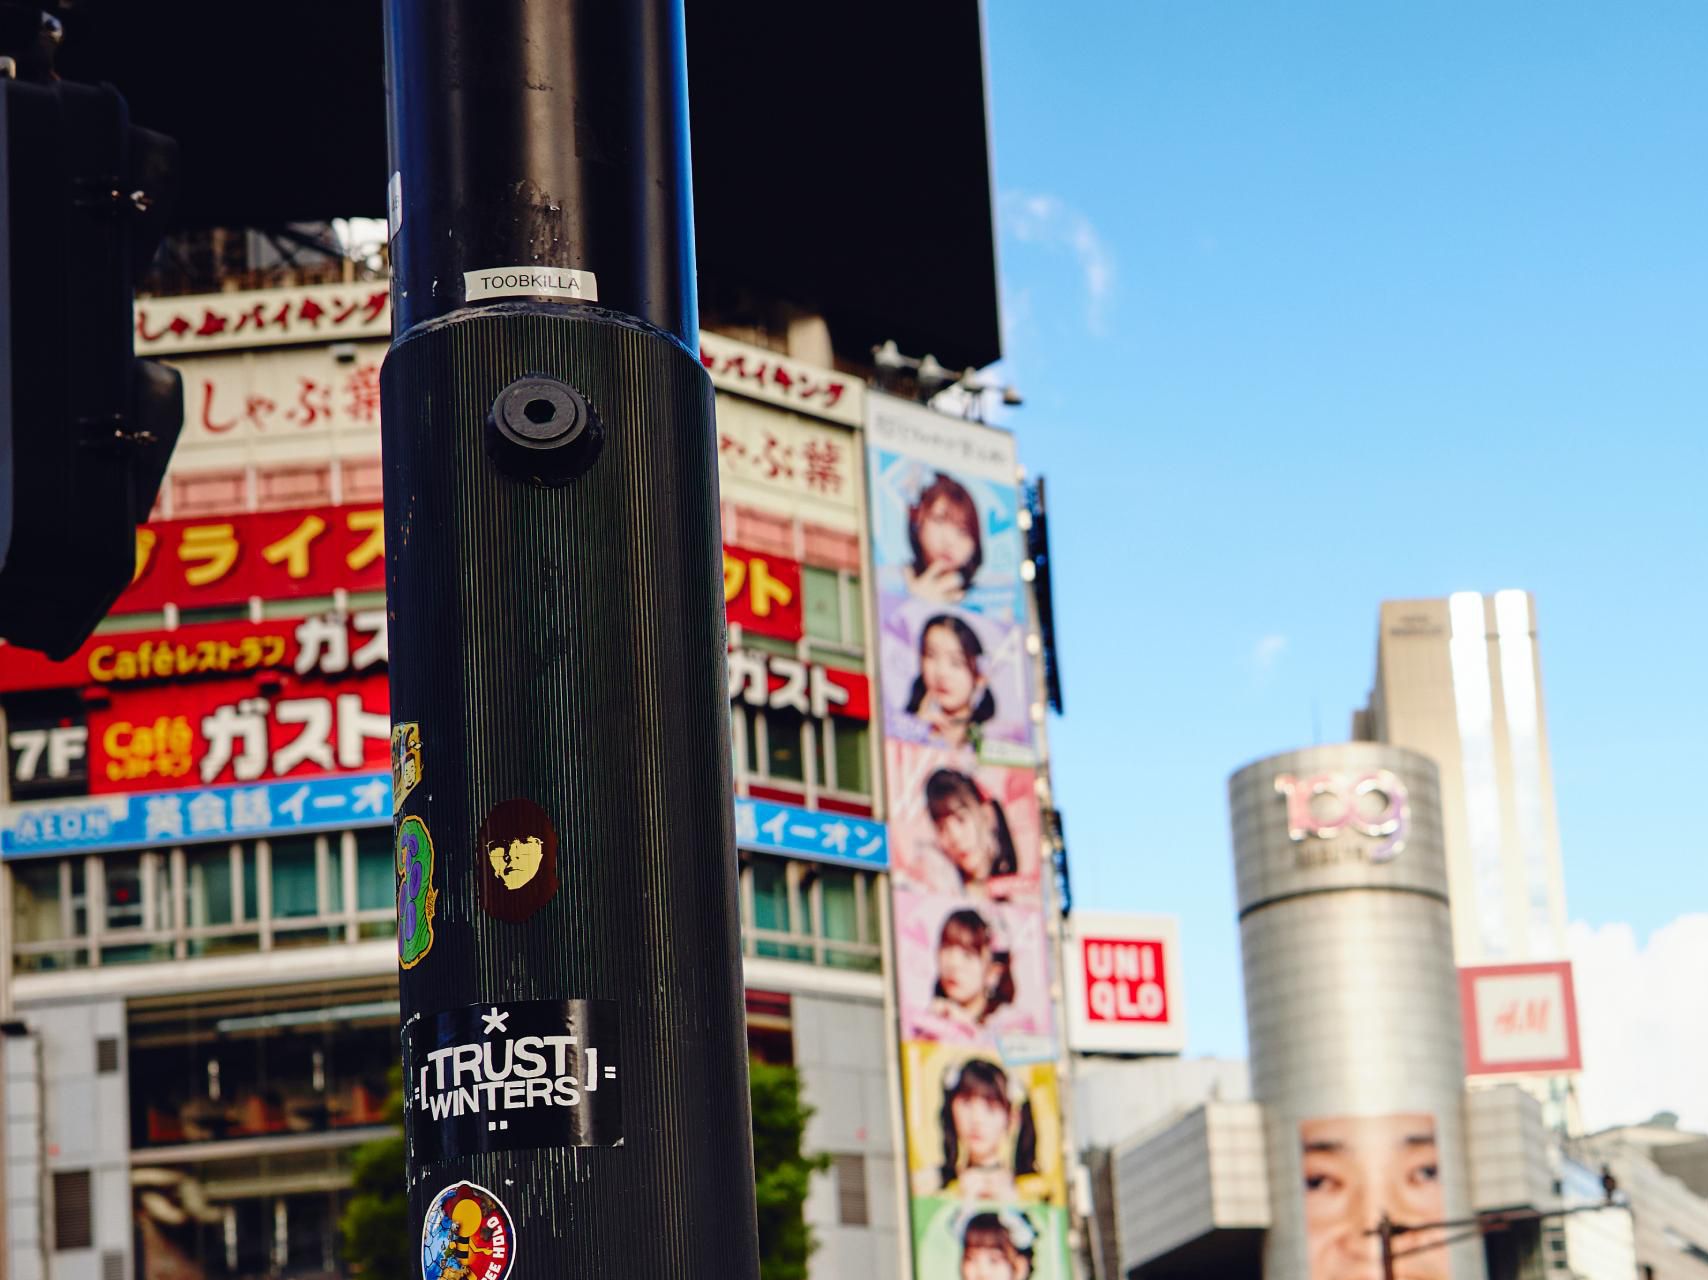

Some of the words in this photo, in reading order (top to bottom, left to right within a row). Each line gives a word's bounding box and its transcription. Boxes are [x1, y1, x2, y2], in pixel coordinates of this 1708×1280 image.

[480, 273, 580, 291] TOOBKILLA
[10, 726, 87, 781] 7F
[103, 718, 193, 760] Café
[200, 695, 390, 783] ガスト
[1088, 943, 1156, 979] UNI
[1090, 979, 1164, 1021] QLO
[427, 1036, 577, 1090] TRUST
[429, 1076, 580, 1121] WINTERS
[487, 1216, 506, 1258] HOLD
